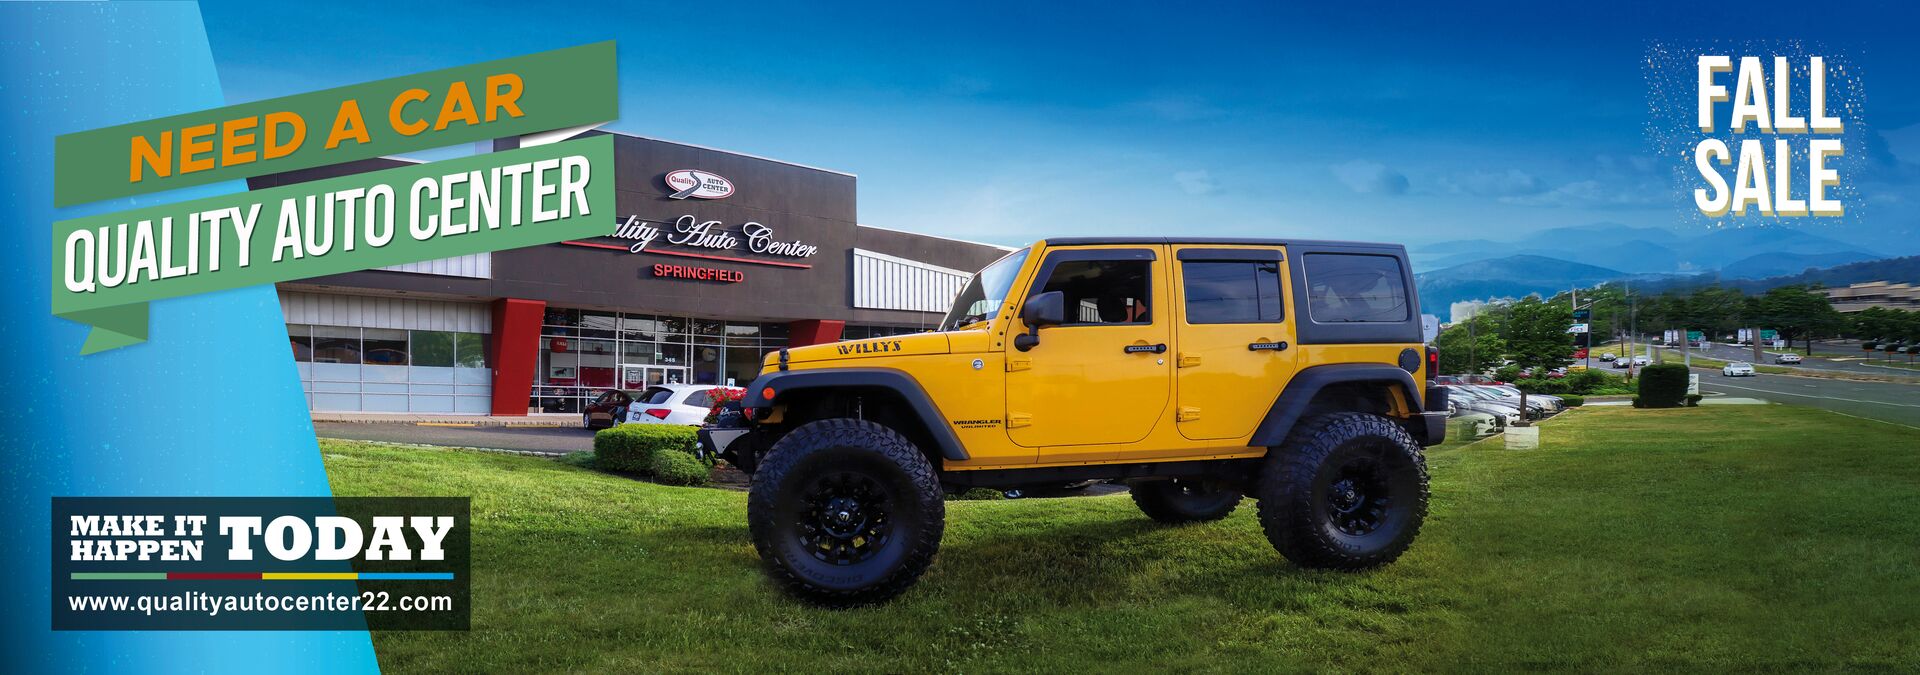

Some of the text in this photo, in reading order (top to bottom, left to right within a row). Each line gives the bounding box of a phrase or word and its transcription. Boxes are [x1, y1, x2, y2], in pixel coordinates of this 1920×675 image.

[670, 175, 696, 187] Quality
[706, 178, 724, 186] AUTO
[702, 183, 729, 193] CENTER
[605, 214, 818, 258] lity Auto Center
[653, 263, 745, 284] SPRINGFIELD
[836, 340, 902, 355] WILLYS
